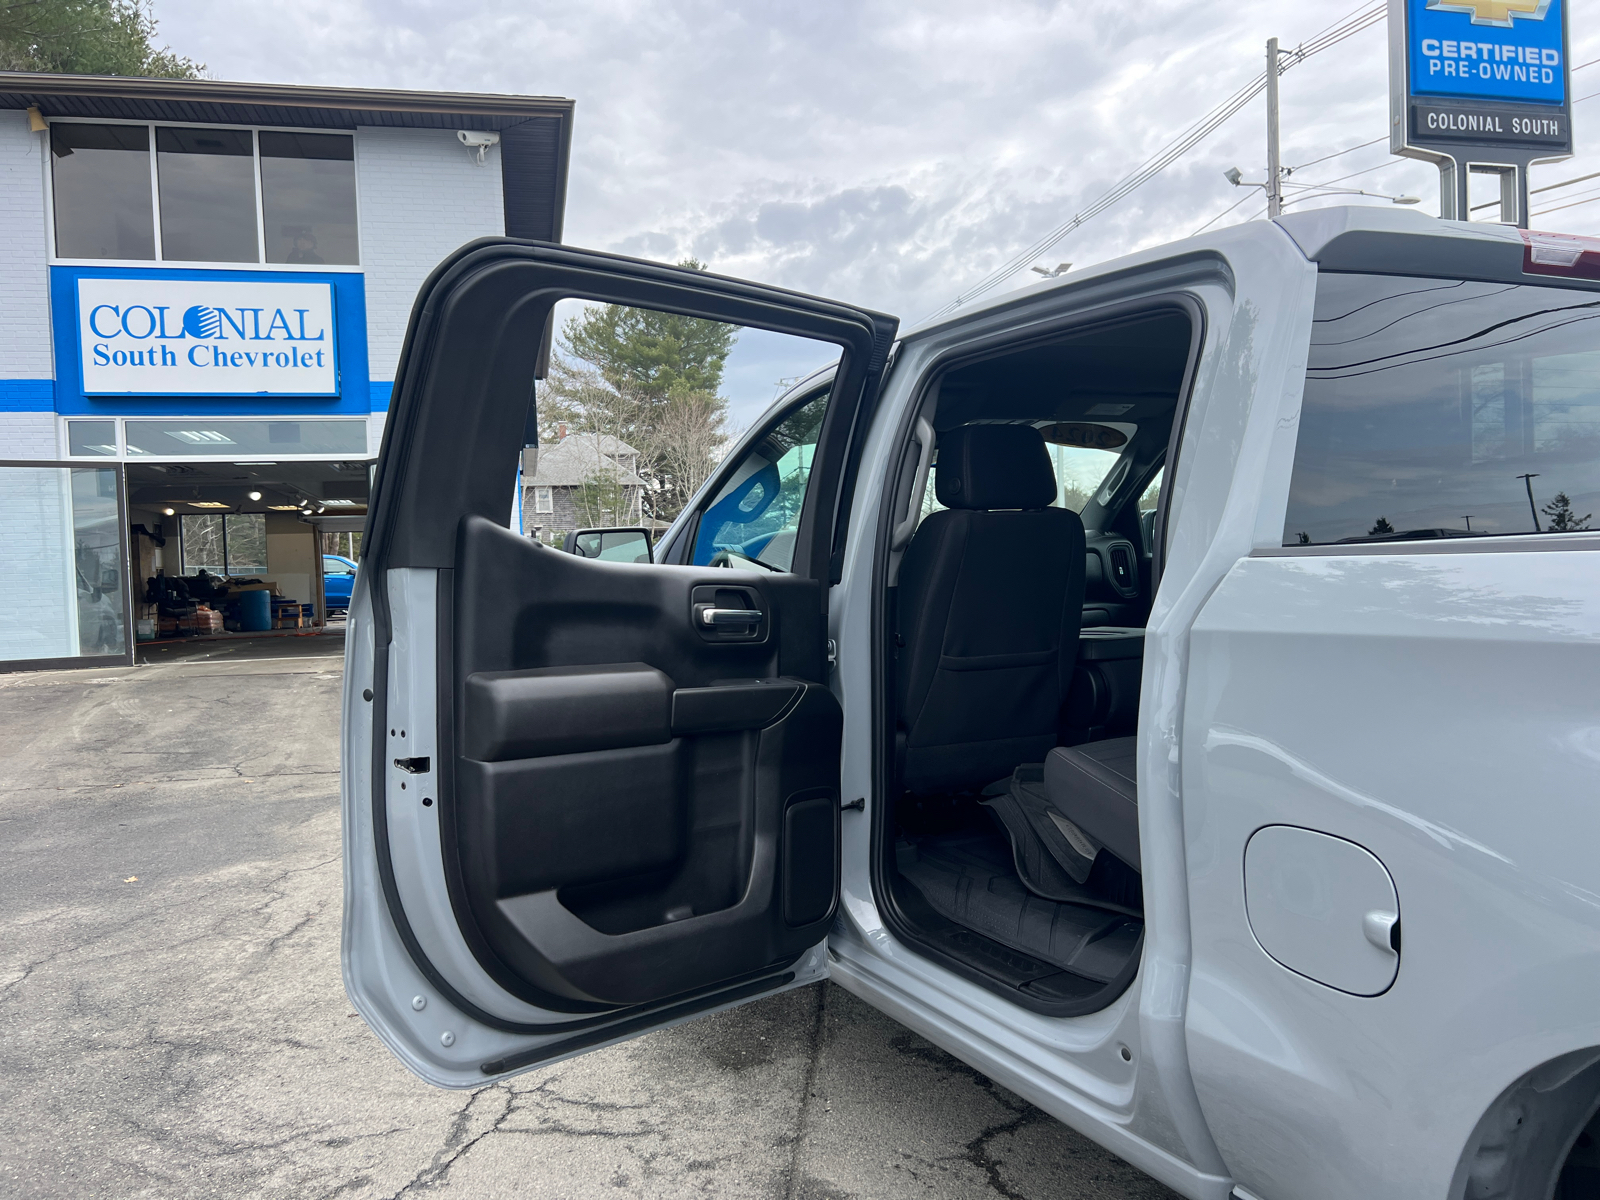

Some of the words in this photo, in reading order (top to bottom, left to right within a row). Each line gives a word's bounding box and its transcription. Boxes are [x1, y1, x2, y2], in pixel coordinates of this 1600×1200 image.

[1421, 38, 1559, 66] CERTIFIED
[1429, 59, 1554, 84] PRE-OWNED
[1427, 112, 1503, 133] COLONIAL
[1512, 117, 1559, 136] SOUTH
[89, 304, 325, 341] COLONIAL
[93, 343, 178, 367] South
[187, 344, 326, 368] Chevrolet
